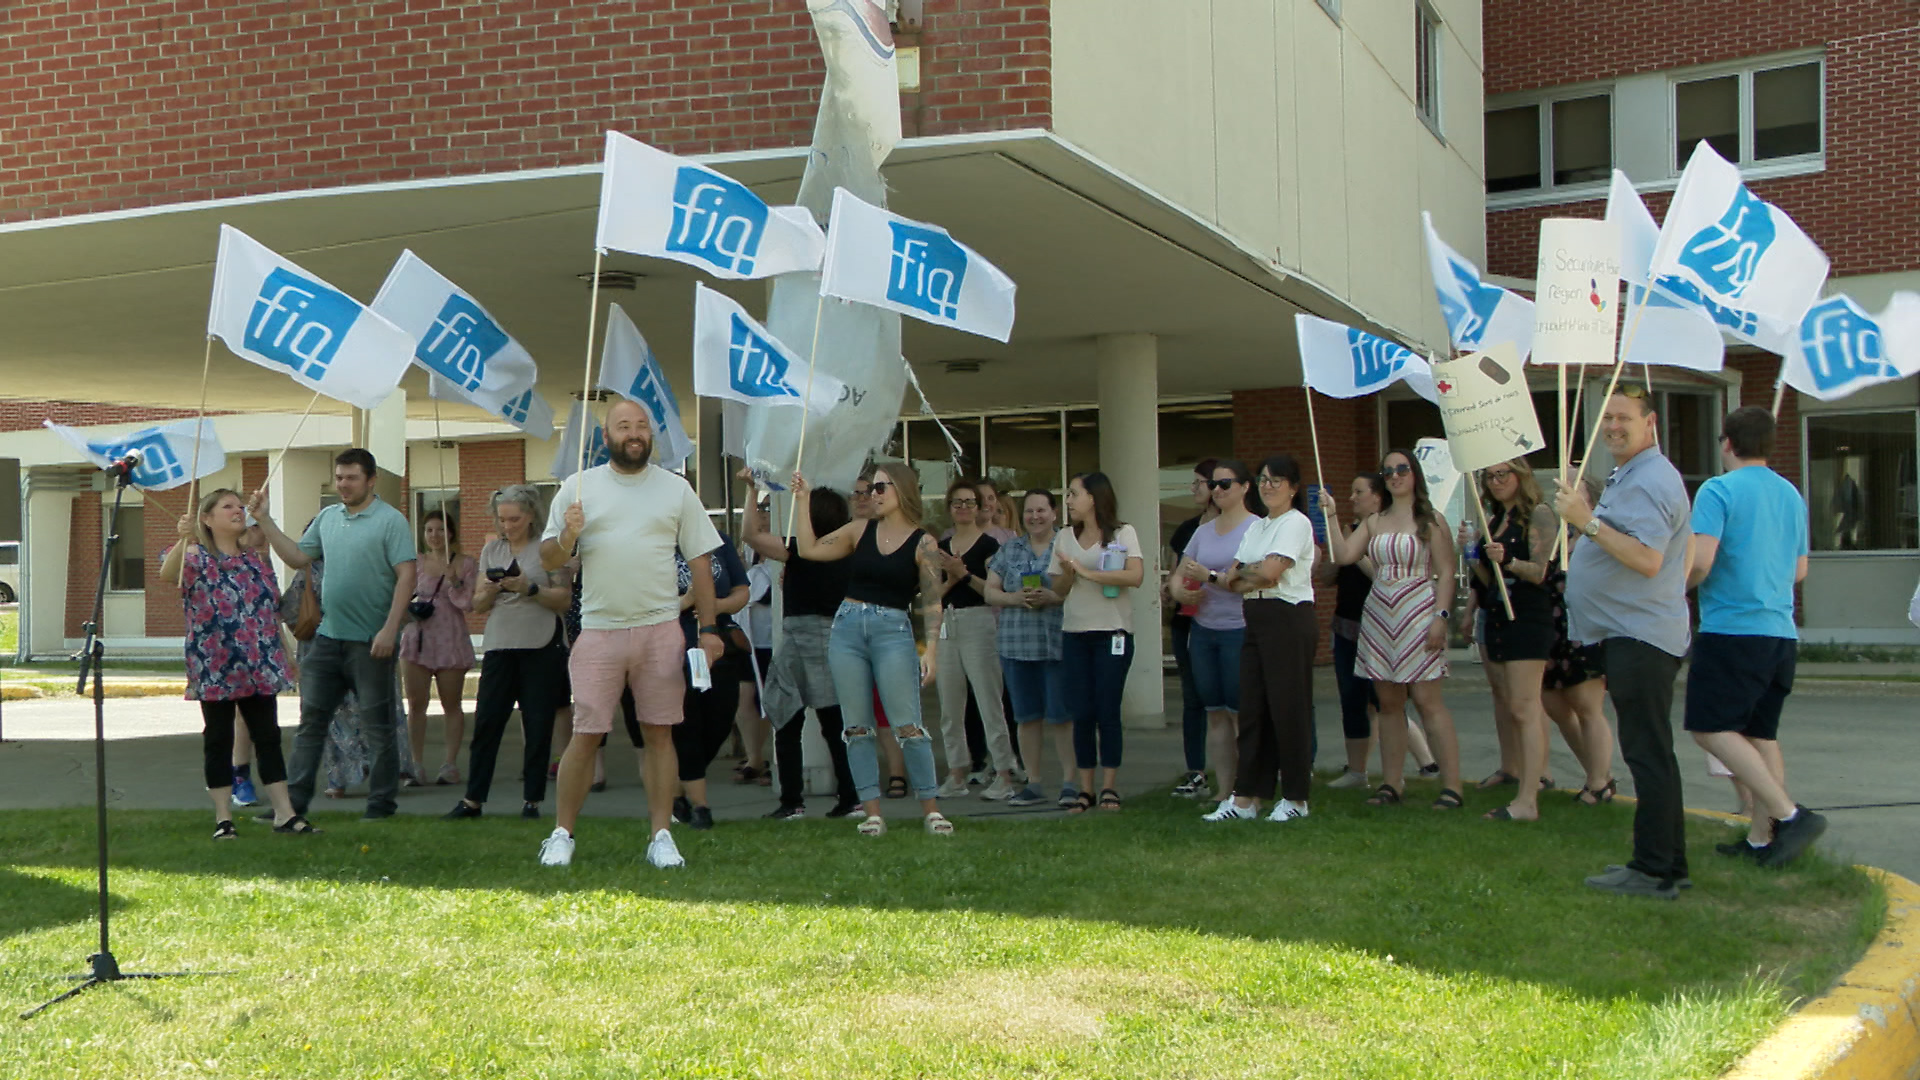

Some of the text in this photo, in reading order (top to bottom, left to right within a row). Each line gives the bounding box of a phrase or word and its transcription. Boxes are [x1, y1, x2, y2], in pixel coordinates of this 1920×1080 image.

[673, 182, 757, 272] fiq
[892, 238, 958, 317] fiq
[254, 285, 332, 375] fiq
[428, 312, 481, 388] fiq
[1801, 307, 1888, 377] fiq
